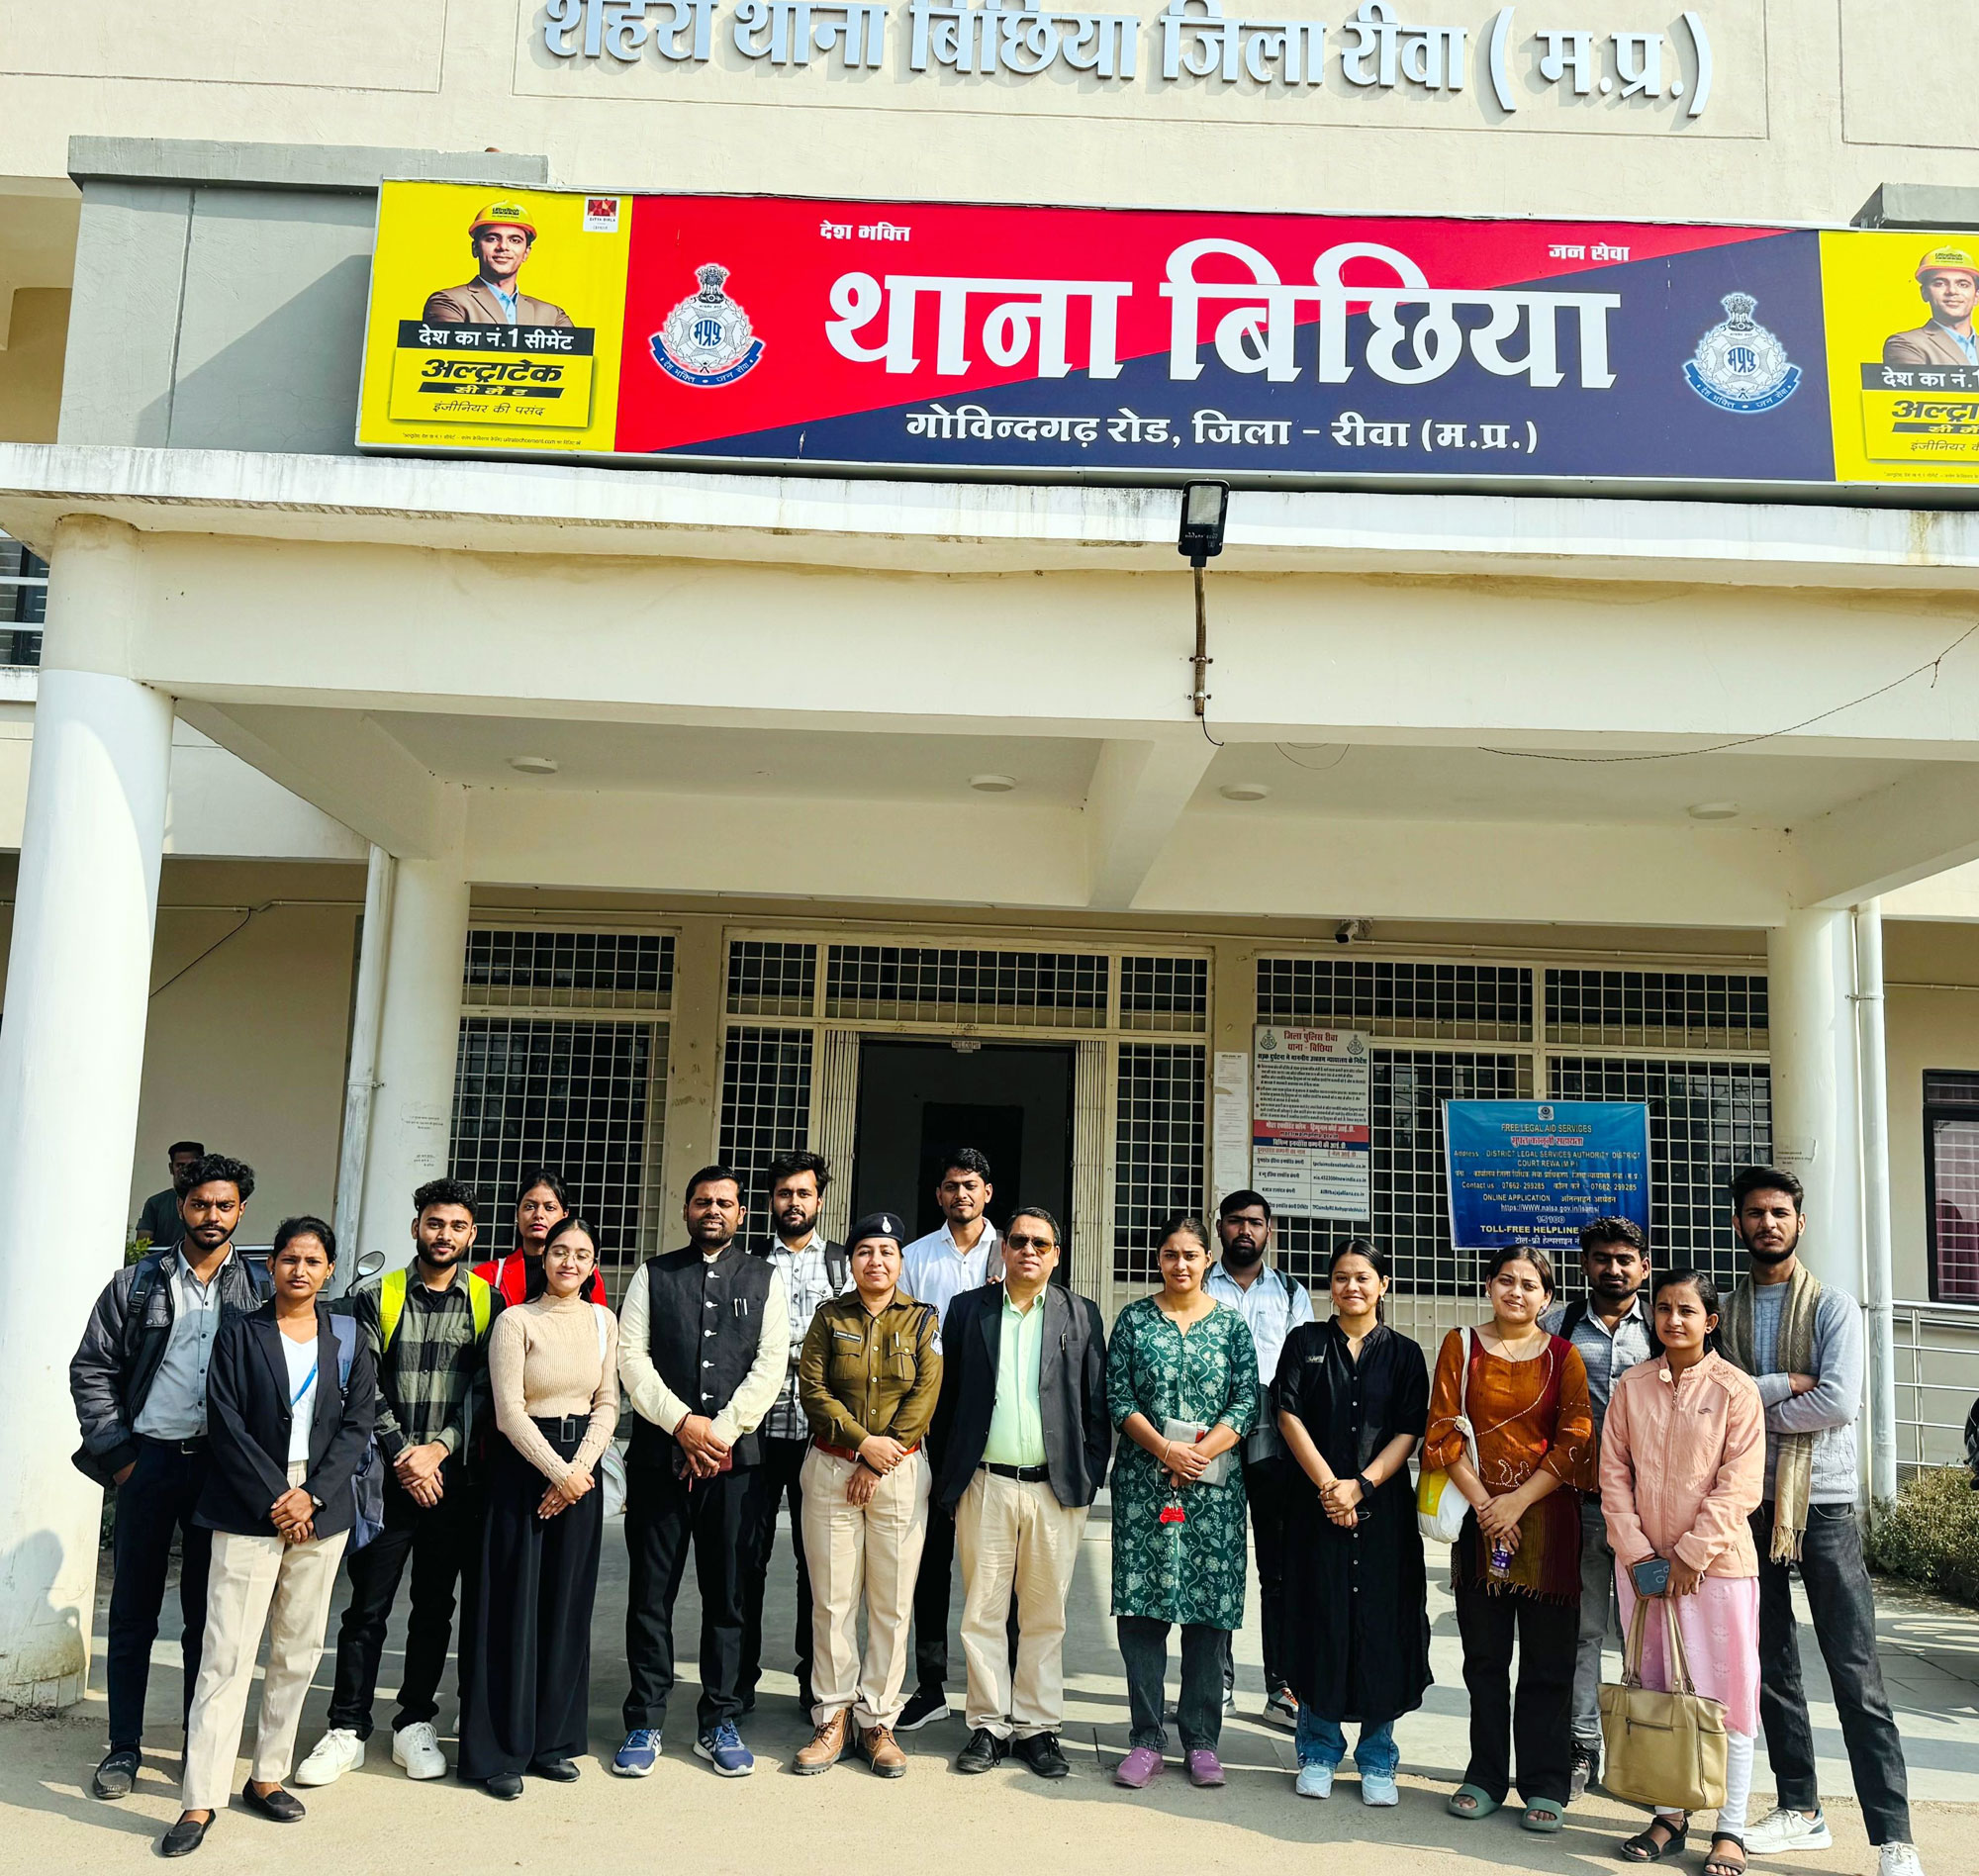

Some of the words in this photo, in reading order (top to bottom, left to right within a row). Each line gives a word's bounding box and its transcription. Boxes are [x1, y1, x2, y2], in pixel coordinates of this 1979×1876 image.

[733, 0, 888, 68] थाना
[1161, 0, 1326, 86] जिला
[1341, 0, 1468, 92] रीवा
[820, 221, 852, 240] देश
[859, 222, 911, 242] भक्ति
[1548, 243, 1586, 260] जन
[1590, 241, 1630, 261] सेवा
[825, 271, 1132, 378] थाना
[1160, 237, 1621, 389] बिछिया
[419, 324, 447, 345] देश
[455, 329, 479, 345] का
[524, 328, 574, 350] सीमेंट
[422, 359, 564, 383] अल्ट्राटेक
[1882, 366, 1912, 386] देश
[1919, 372, 1945, 387] का
[432, 400, 488, 414] इंजीनियर
[493, 402, 511, 414] की
[516, 406, 544, 417] पसंद
[906, 403, 1100, 448] गोविन्दगढ़
[1107, 407, 1180, 450] रोड,
[1191, 410, 1293, 445] जिला
[1332, 411, 1410, 447] रीवा
[1421, 421, 1538, 454] (म.प्र.)
[1910, 440, 1966, 452] इंजीनियर
